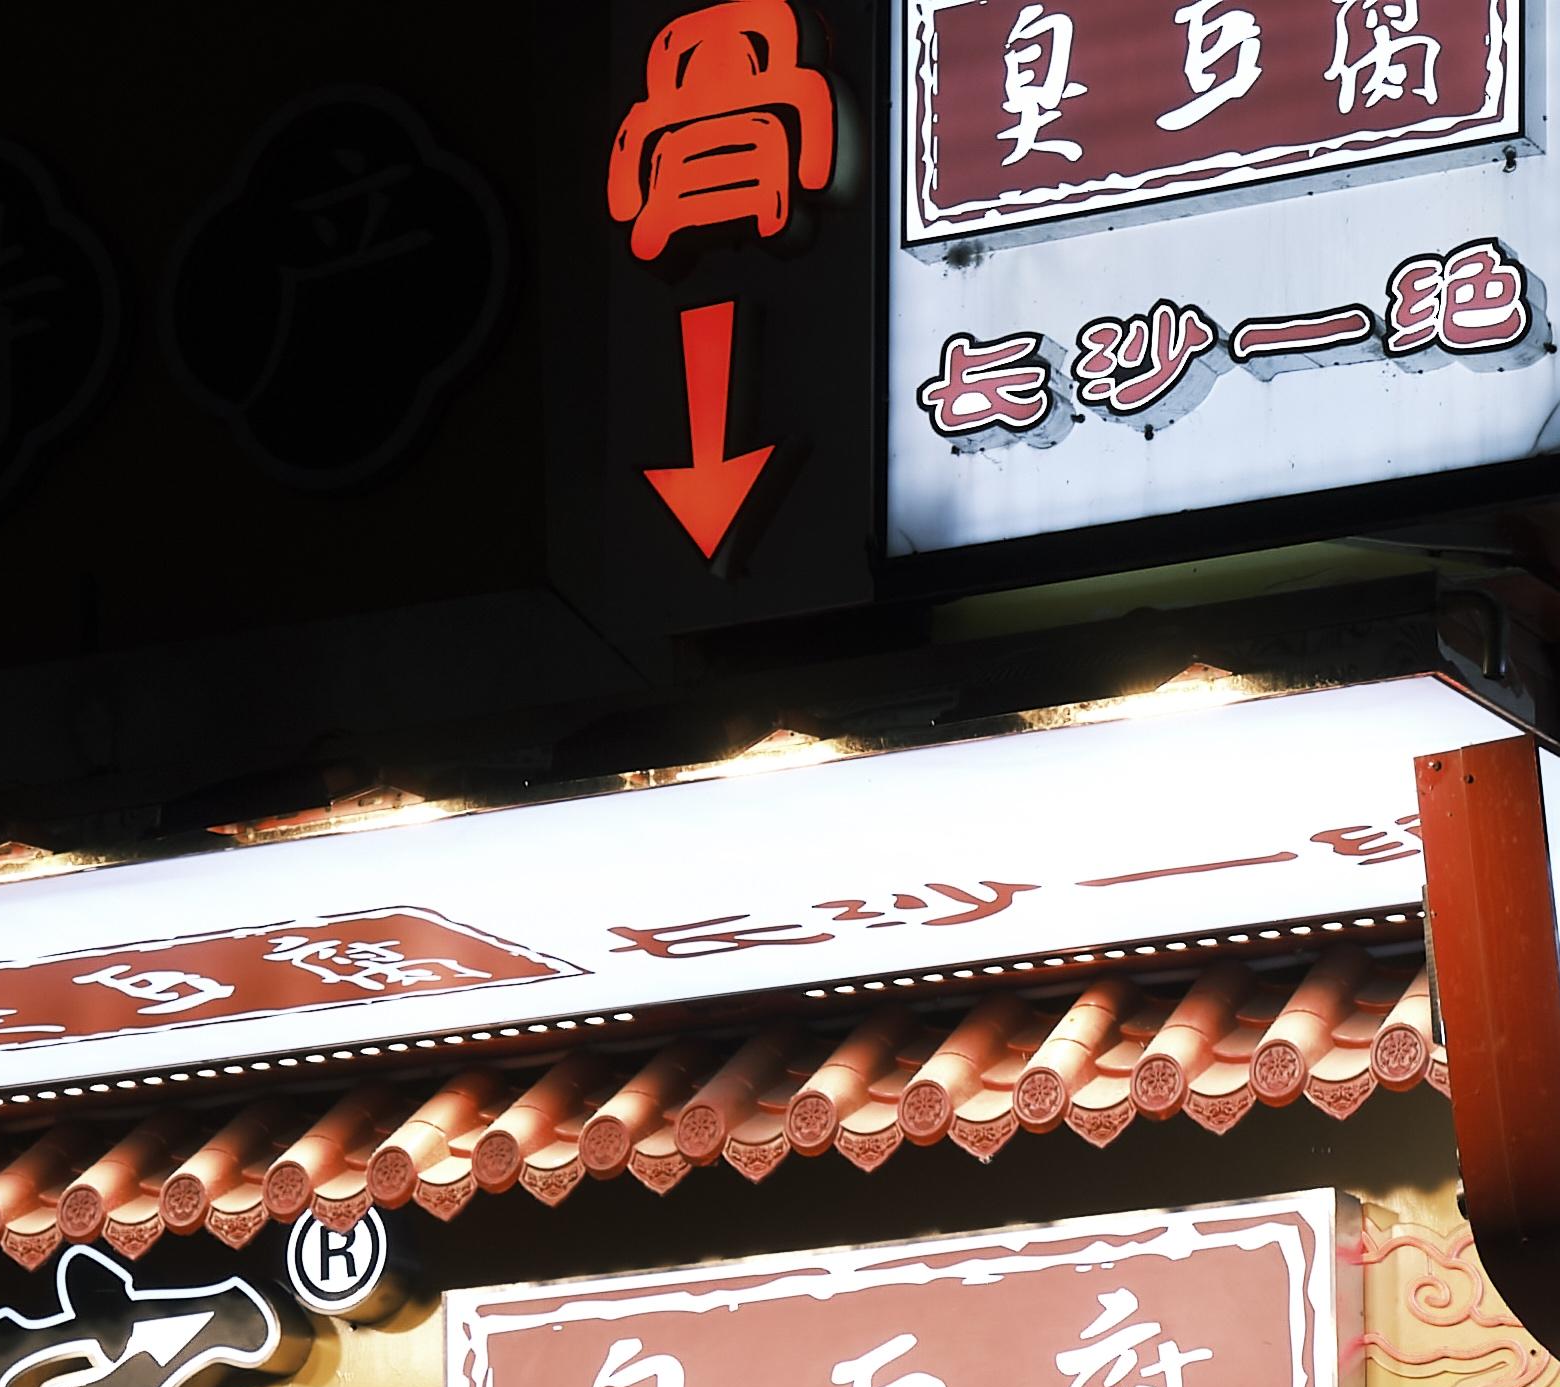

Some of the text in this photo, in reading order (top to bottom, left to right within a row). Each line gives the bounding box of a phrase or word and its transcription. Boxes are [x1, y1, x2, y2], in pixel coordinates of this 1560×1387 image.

[1000, 0, 1443, 168] 臭豆腐
[916, 236, 1534, 440] 长沙一绝
